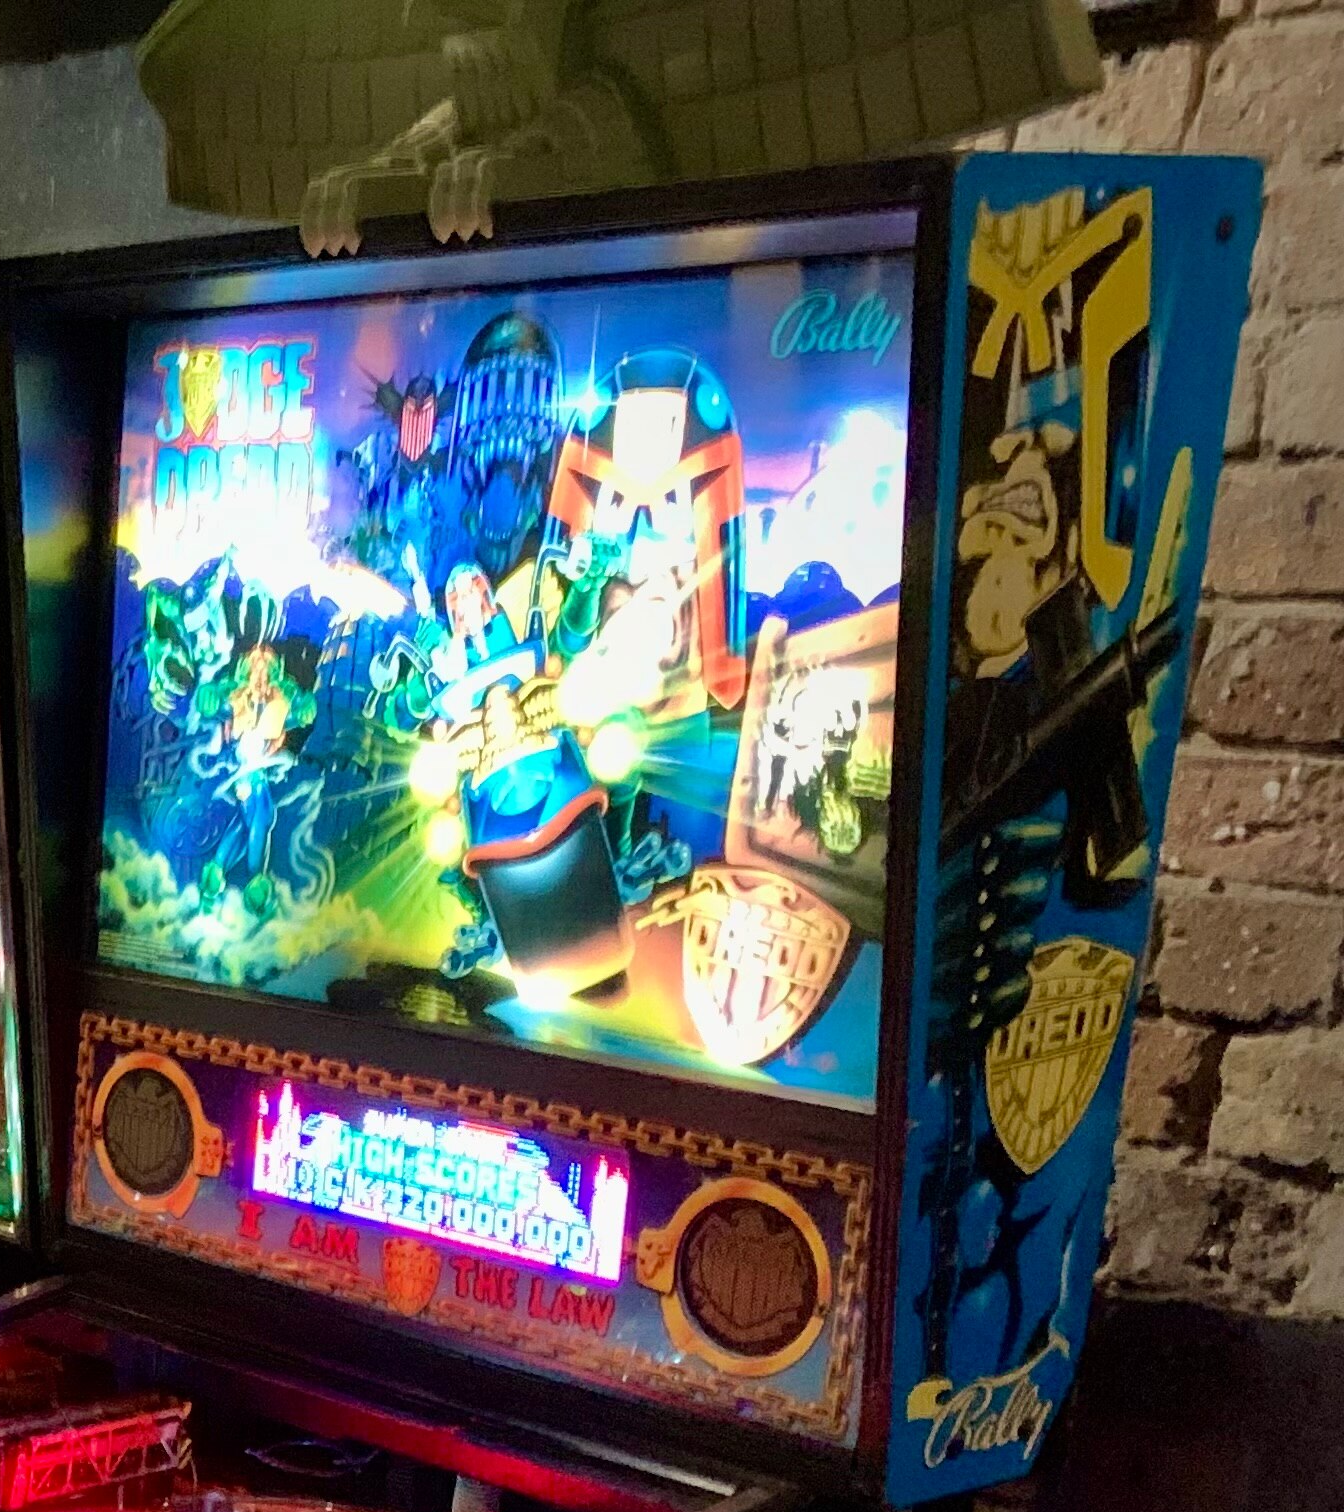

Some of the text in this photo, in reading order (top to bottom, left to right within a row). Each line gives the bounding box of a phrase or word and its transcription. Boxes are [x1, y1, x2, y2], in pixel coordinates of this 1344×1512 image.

[771, 289, 903, 366] Bally
[988, 993, 1124, 1060] DREDD
[336, 1122, 406, 1182] HIGH
[414, 1150, 539, 1212] SCORES
[238, 1201, 360, 1264] I AM
[450, 1255, 614, 1337] THE LAW
[923, 1376, 1053, 1469] Bally
